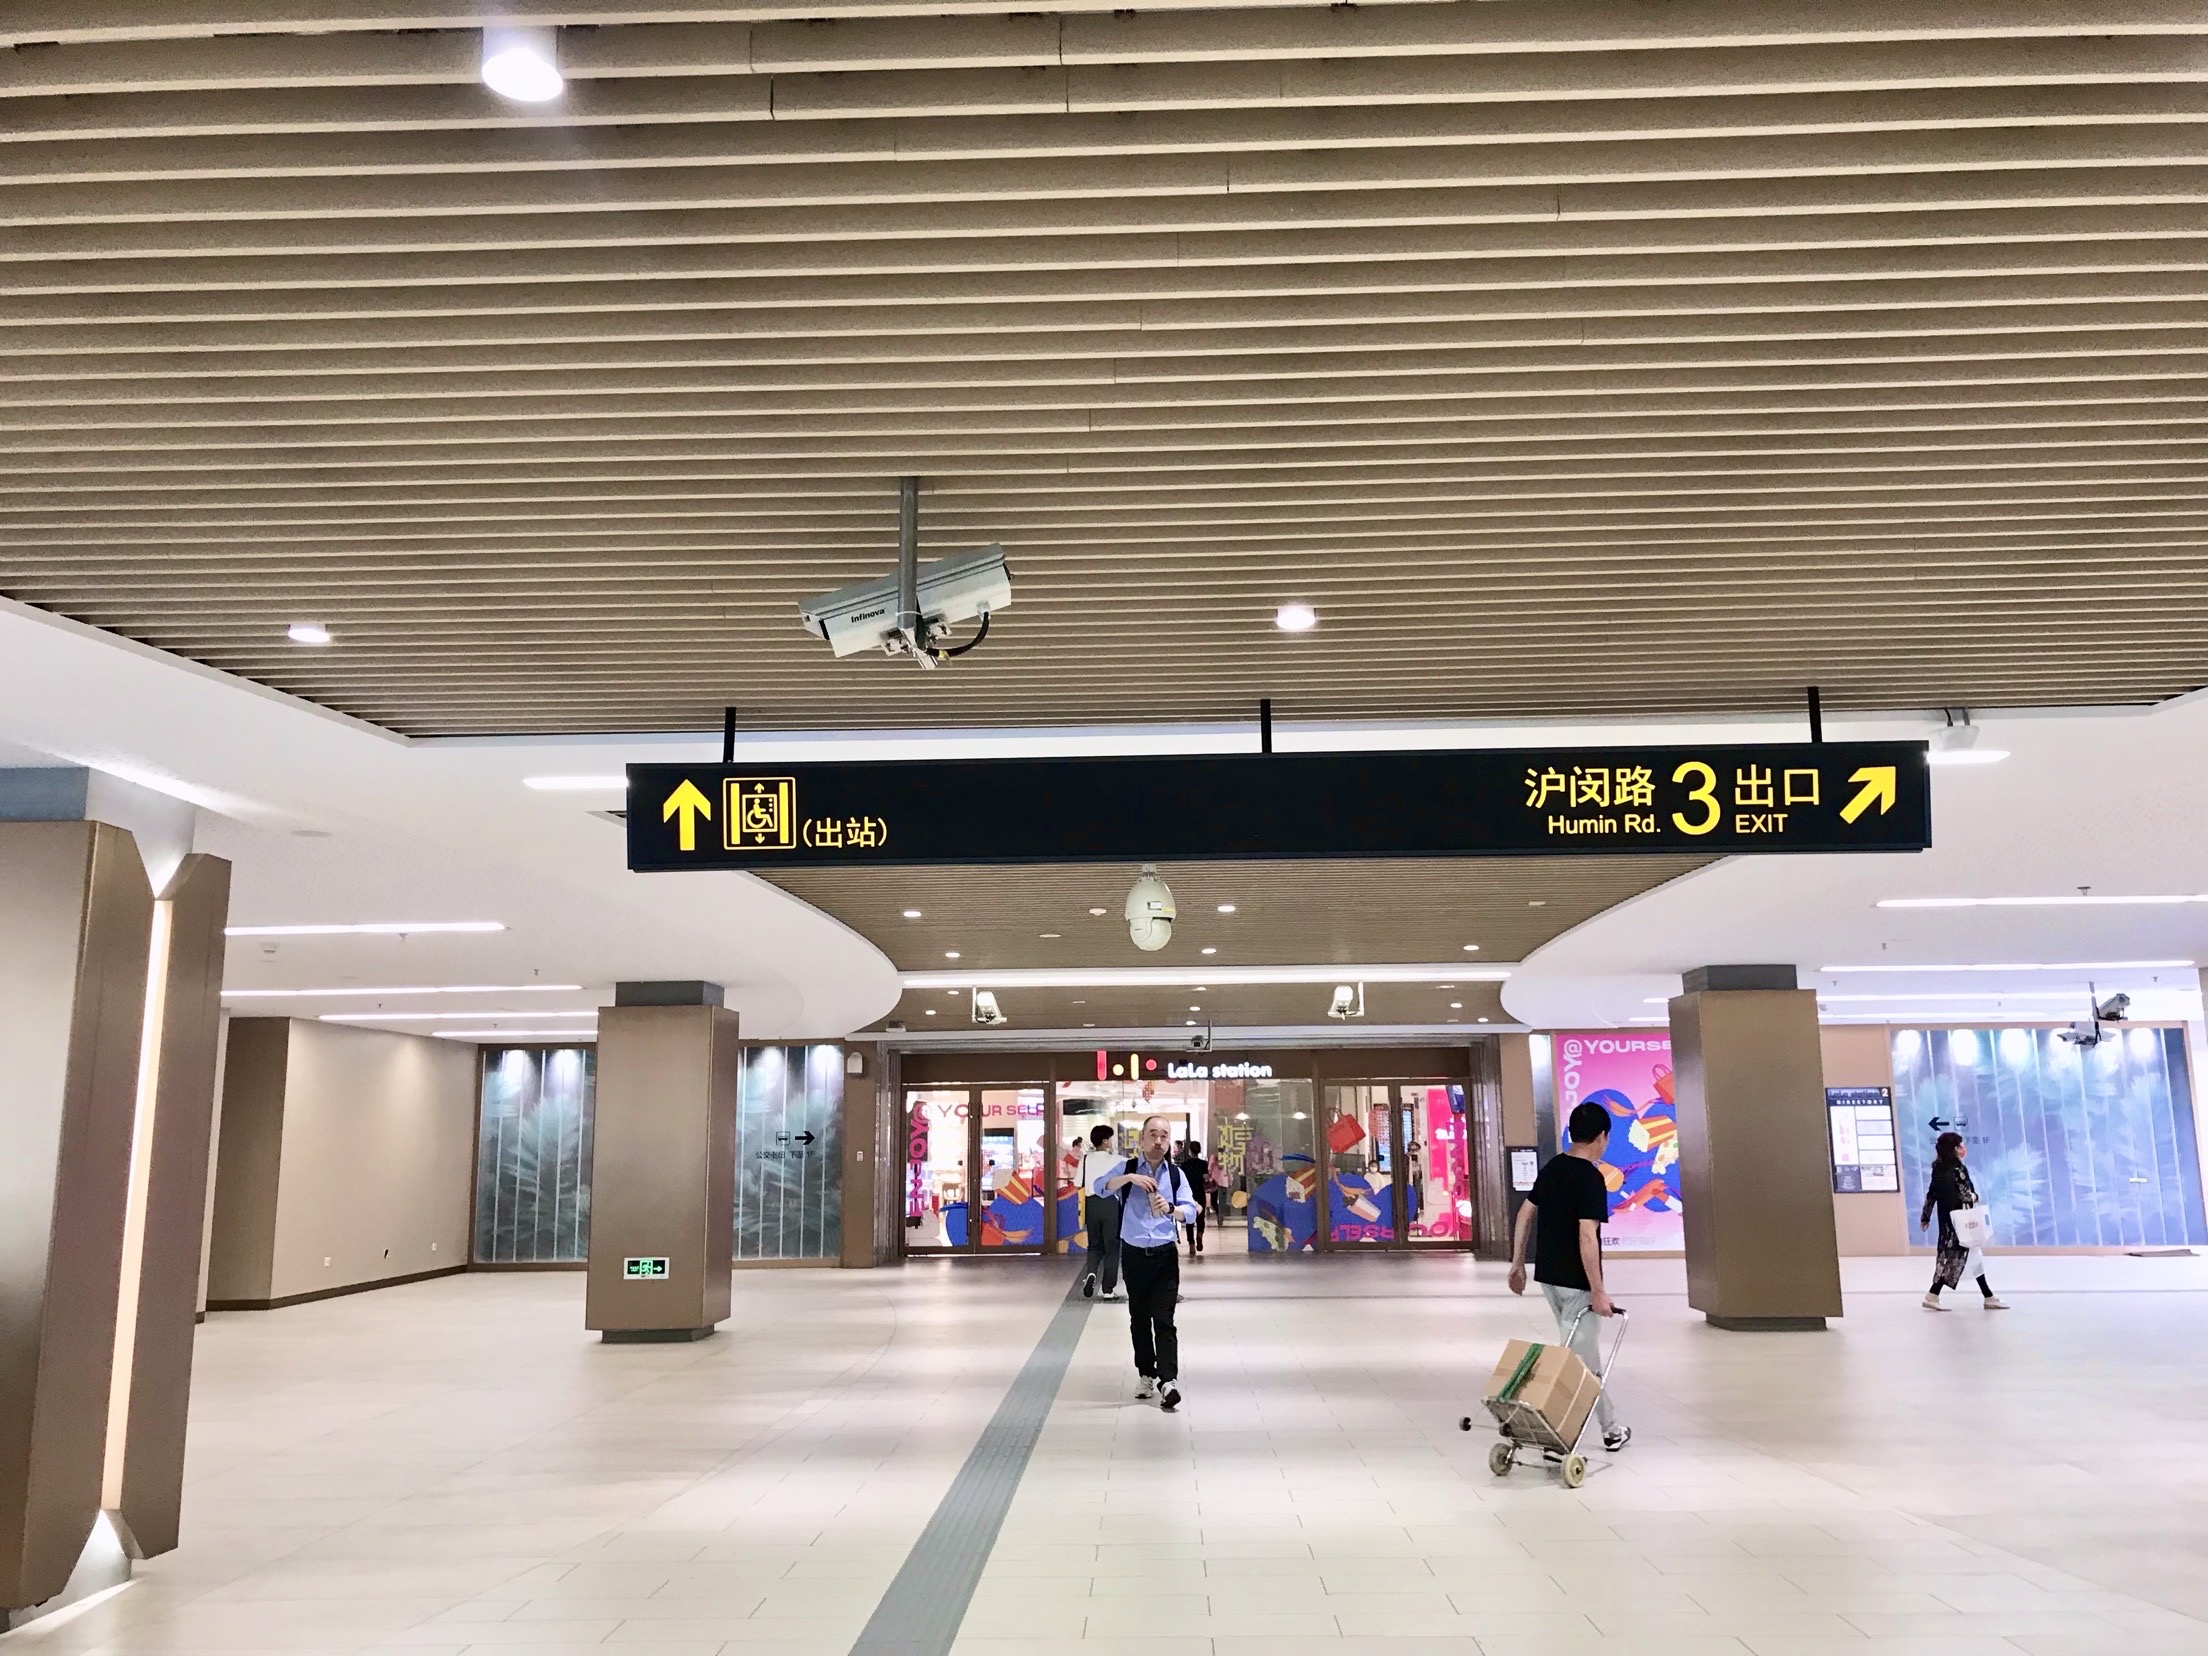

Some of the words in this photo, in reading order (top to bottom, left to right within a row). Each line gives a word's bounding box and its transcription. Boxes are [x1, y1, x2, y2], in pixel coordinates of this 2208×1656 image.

[851, 609, 885, 623] Infinova
[1524, 765, 1656, 809] 沪闵路
[1734, 763, 1820, 808] 出口
[1671, 761, 1721, 836] 3
[1548, 814, 1618, 834] Humin
[1624, 813, 1661, 833] Rd.
[1735, 813, 1788, 833] EXIT
[1167, 1062, 1208, 1079] LaLa
[1212, 1062, 1272, 1078] station
